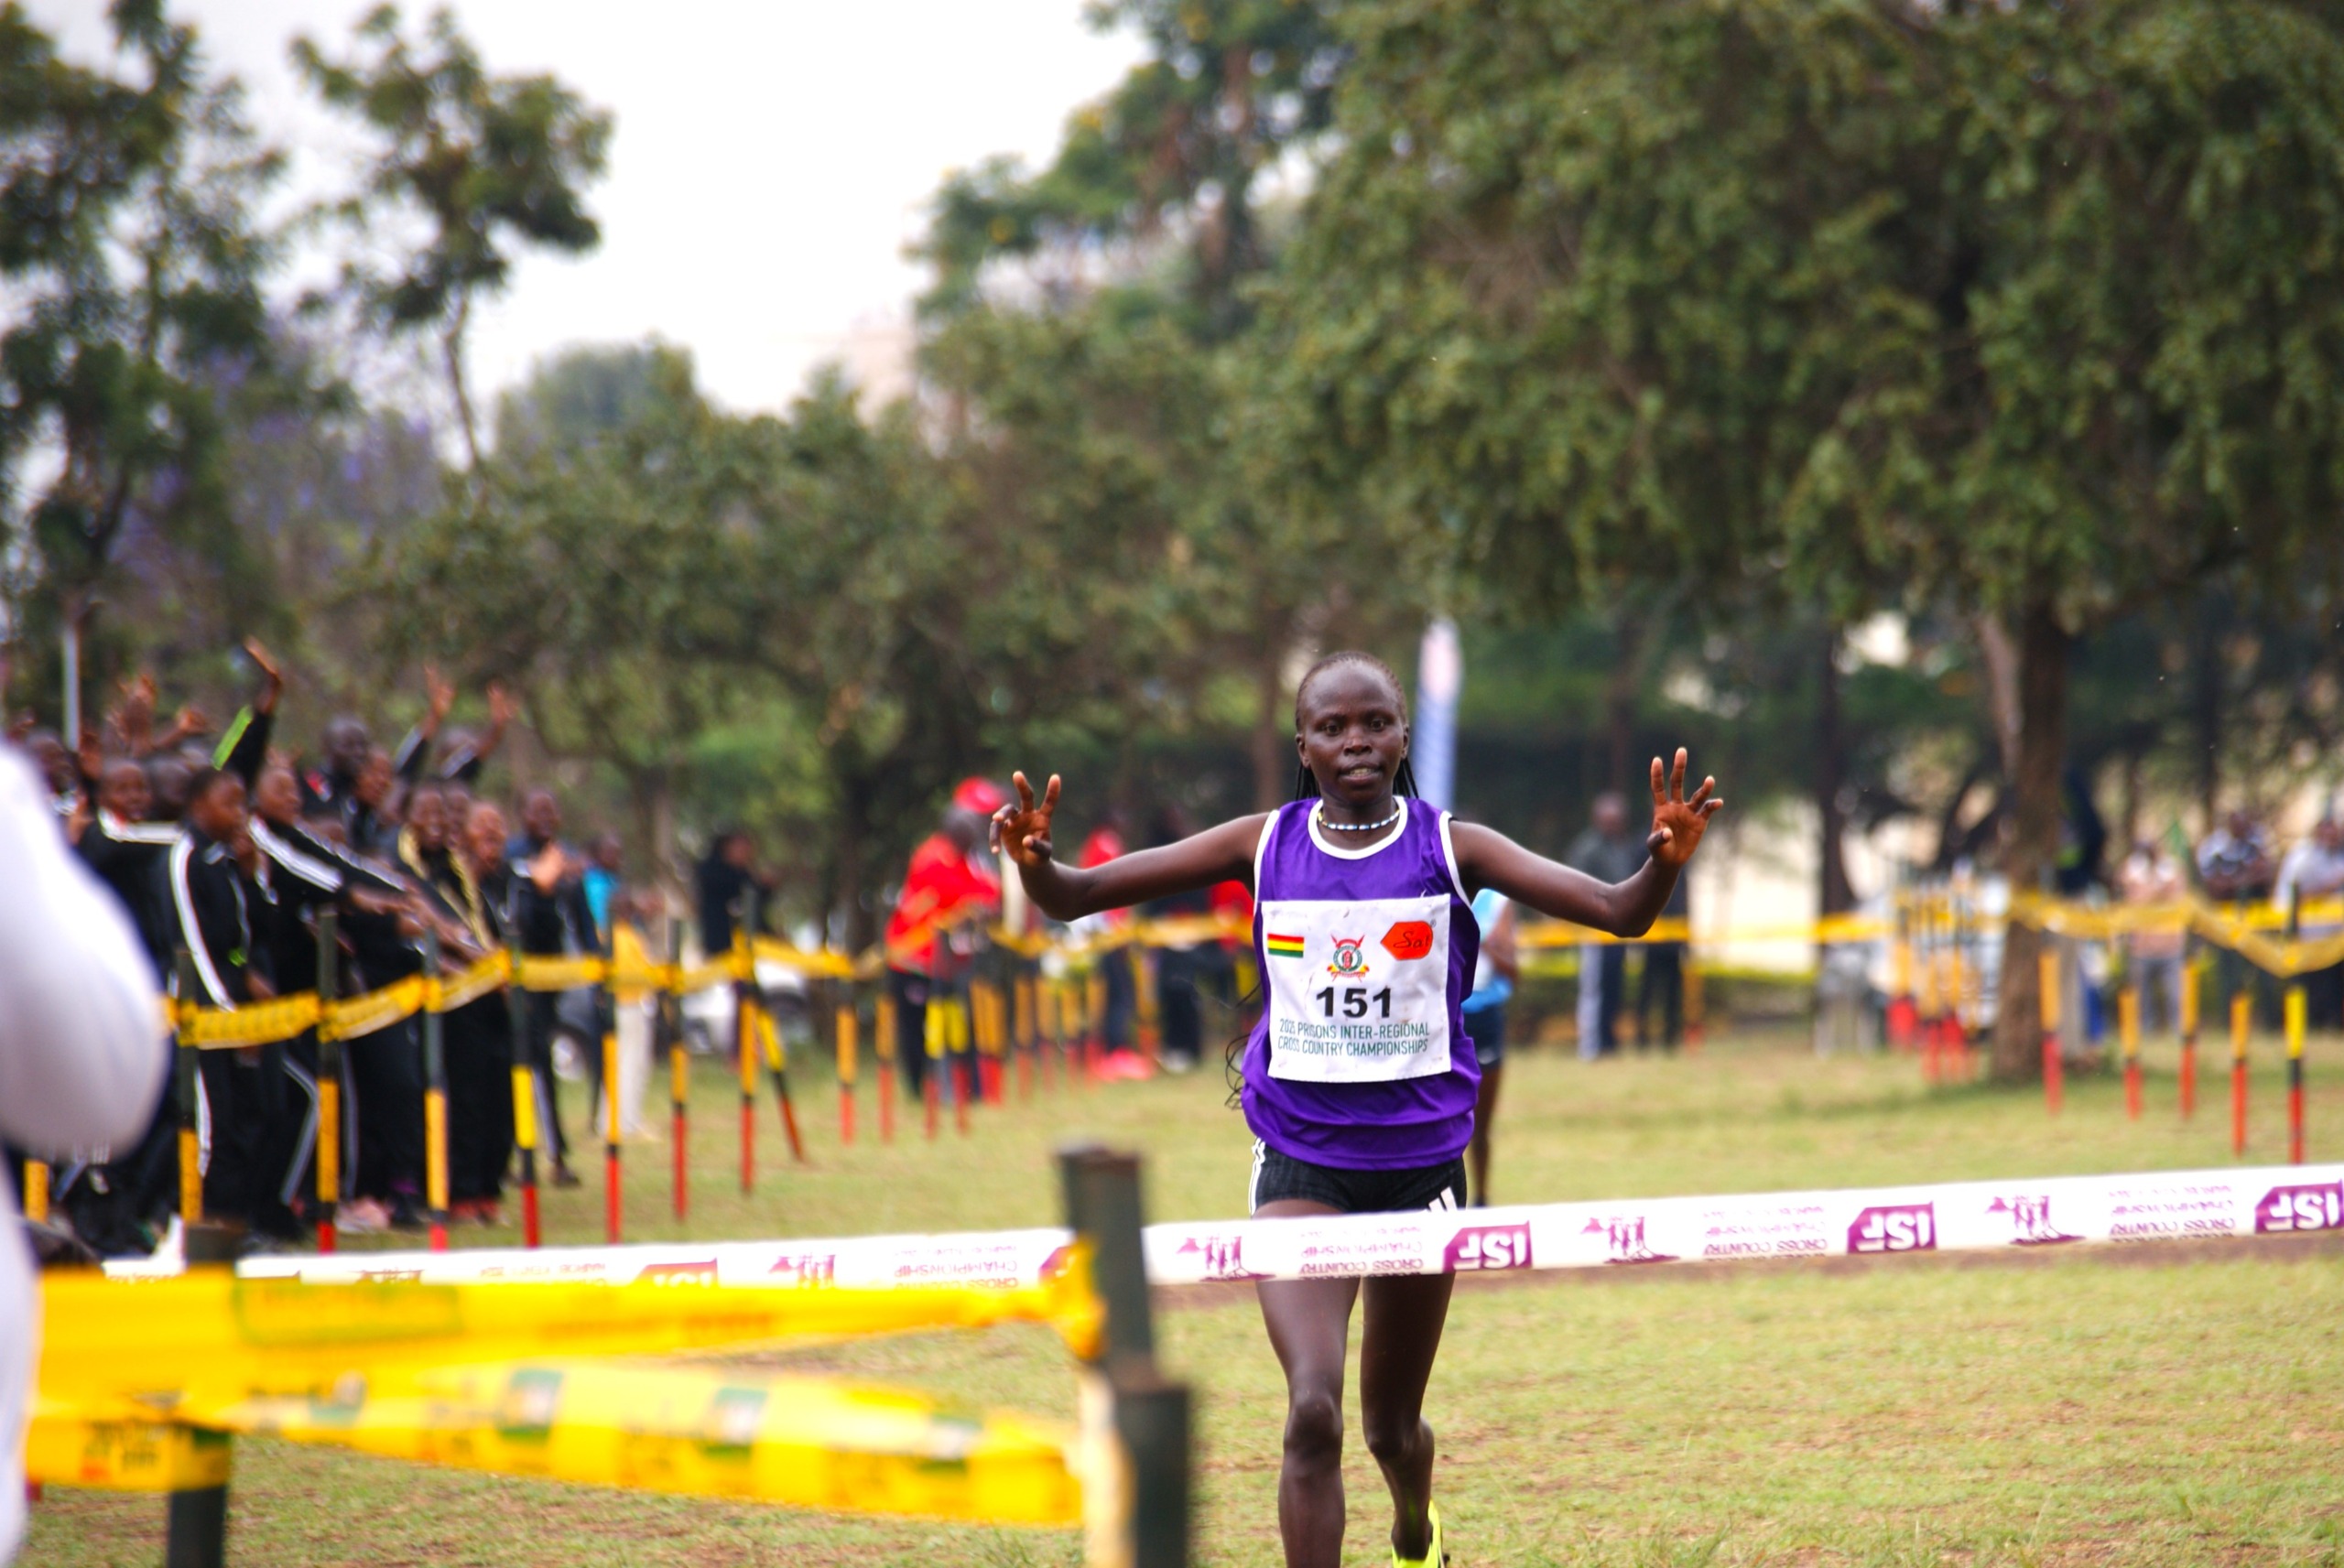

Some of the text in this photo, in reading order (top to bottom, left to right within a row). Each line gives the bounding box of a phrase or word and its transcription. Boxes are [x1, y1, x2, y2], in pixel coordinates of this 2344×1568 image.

[1316, 986, 1391, 1019] 151
[1277, 1035, 1428, 1057] CROSS COUNTRY CHAMPIONSHIPS
[1297, 1022, 1337, 1039] PRISONS
[1340, 1022, 1430, 1040] INTER-REGIONAL
[2265, 1193, 2339, 1230] ISF
[1855, 1213, 1930, 1251] ISF
[1299, 1259, 1423, 1274] CROSS COUNTRY
[1453, 1232, 1526, 1270] ISF
